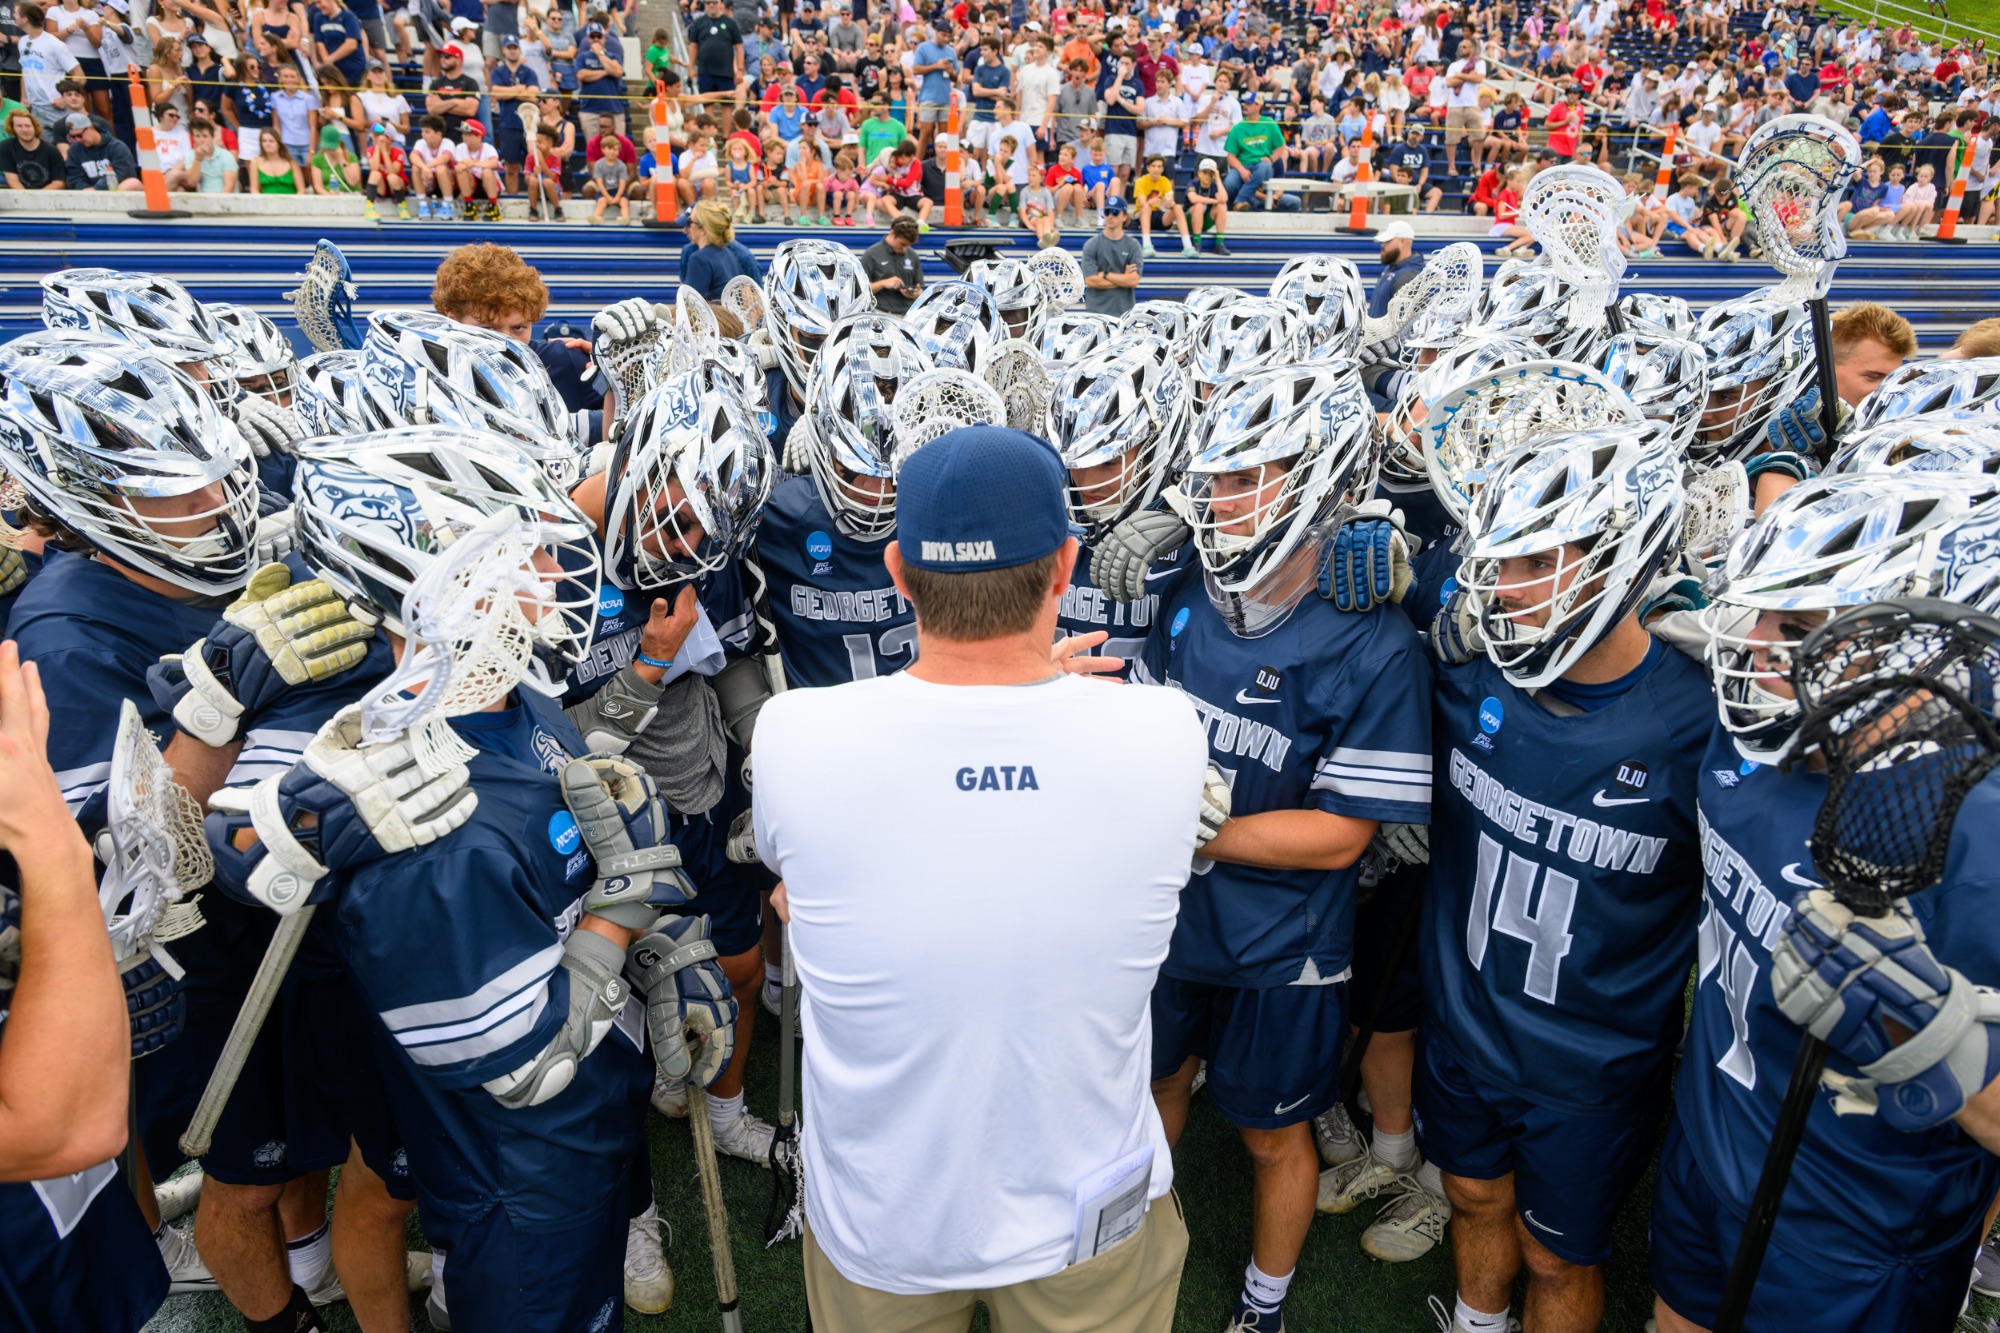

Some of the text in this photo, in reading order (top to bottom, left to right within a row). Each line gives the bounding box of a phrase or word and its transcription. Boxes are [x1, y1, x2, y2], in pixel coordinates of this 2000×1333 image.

[921, 540, 997, 561] HOYA SAXA
[597, 598, 624, 611] NCAA
[790, 584, 916, 623] GEORGET
[1255, 669, 1281, 691] DJU
[1480, 709, 1500, 730] NCAA
[956, 765, 1039, 792] GATA
[1616, 765, 1648, 788] DJU
[1449, 747, 1669, 874] GEORGETOWN
[744, 845, 756, 859] 45
[1467, 830, 1580, 1005] 14
[1369, 1175, 1408, 1194] balane
